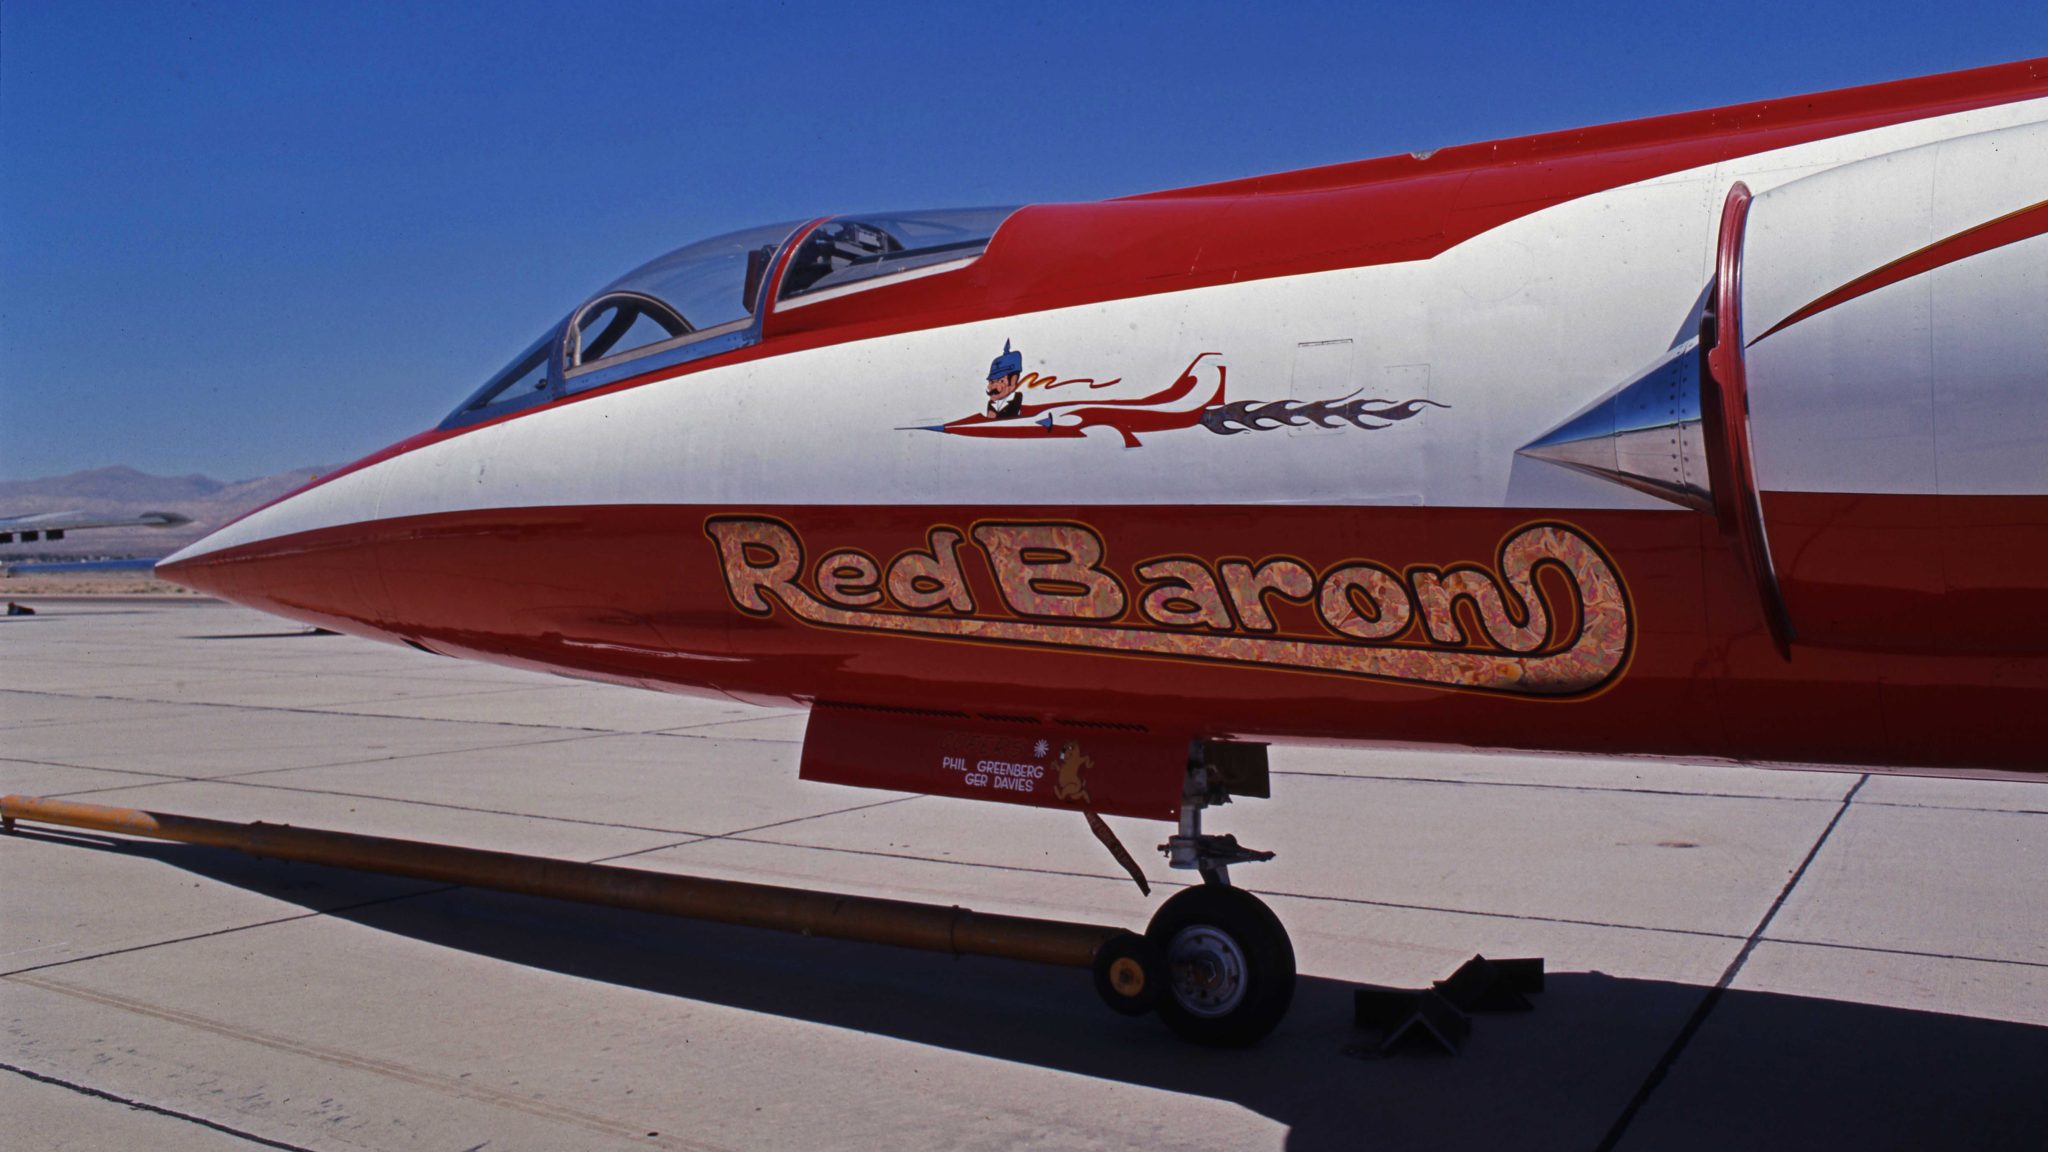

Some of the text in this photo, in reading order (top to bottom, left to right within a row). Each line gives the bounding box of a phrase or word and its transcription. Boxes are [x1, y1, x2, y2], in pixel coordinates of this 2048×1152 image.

[704, 513, 1635, 701] Red Baron
[942, 756, 1045, 779] PHIL GREENBERG
[964, 772, 1035, 792] GER DAVIES
